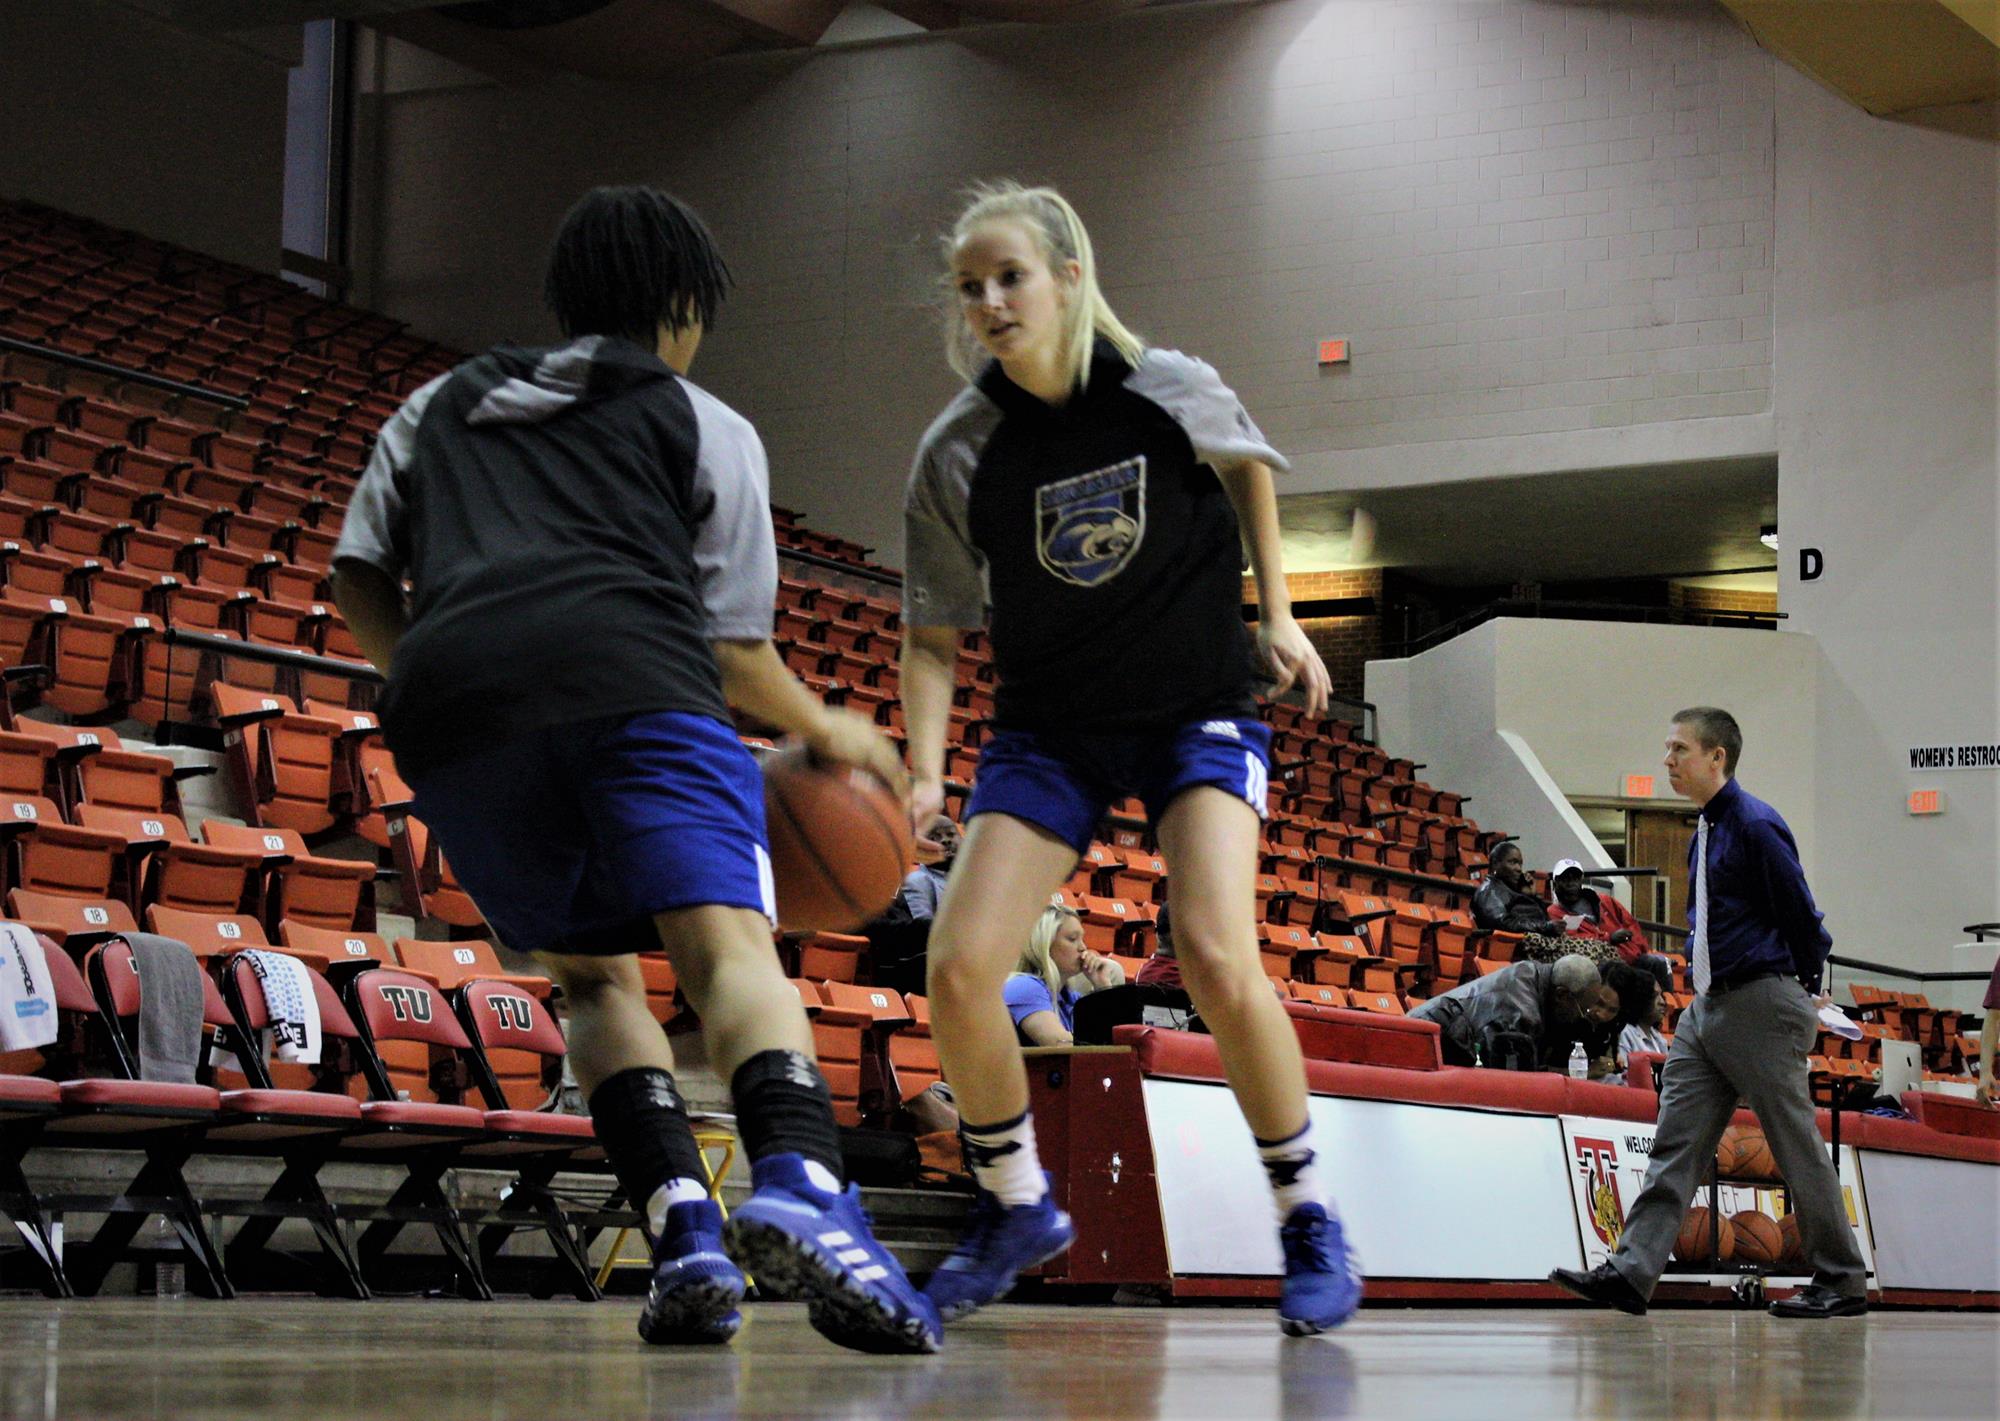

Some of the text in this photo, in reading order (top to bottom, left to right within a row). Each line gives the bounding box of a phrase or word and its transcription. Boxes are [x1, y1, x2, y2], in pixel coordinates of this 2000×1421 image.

[1800, 548, 1823, 580] D
[1909, 747, 1954, 768] WOMEN'S
[19, 805, 31, 818] 19
[145, 821, 161, 834] 20
[268, 836, 280, 849] 21
[89, 909, 103, 922] 18
[222, 923, 235, 937] 19
[348, 940, 363, 954] 20
[459, 950, 471, 963] 21
[379, 985, 433, 1023] TU
[485, 995, 533, 1031] TU
